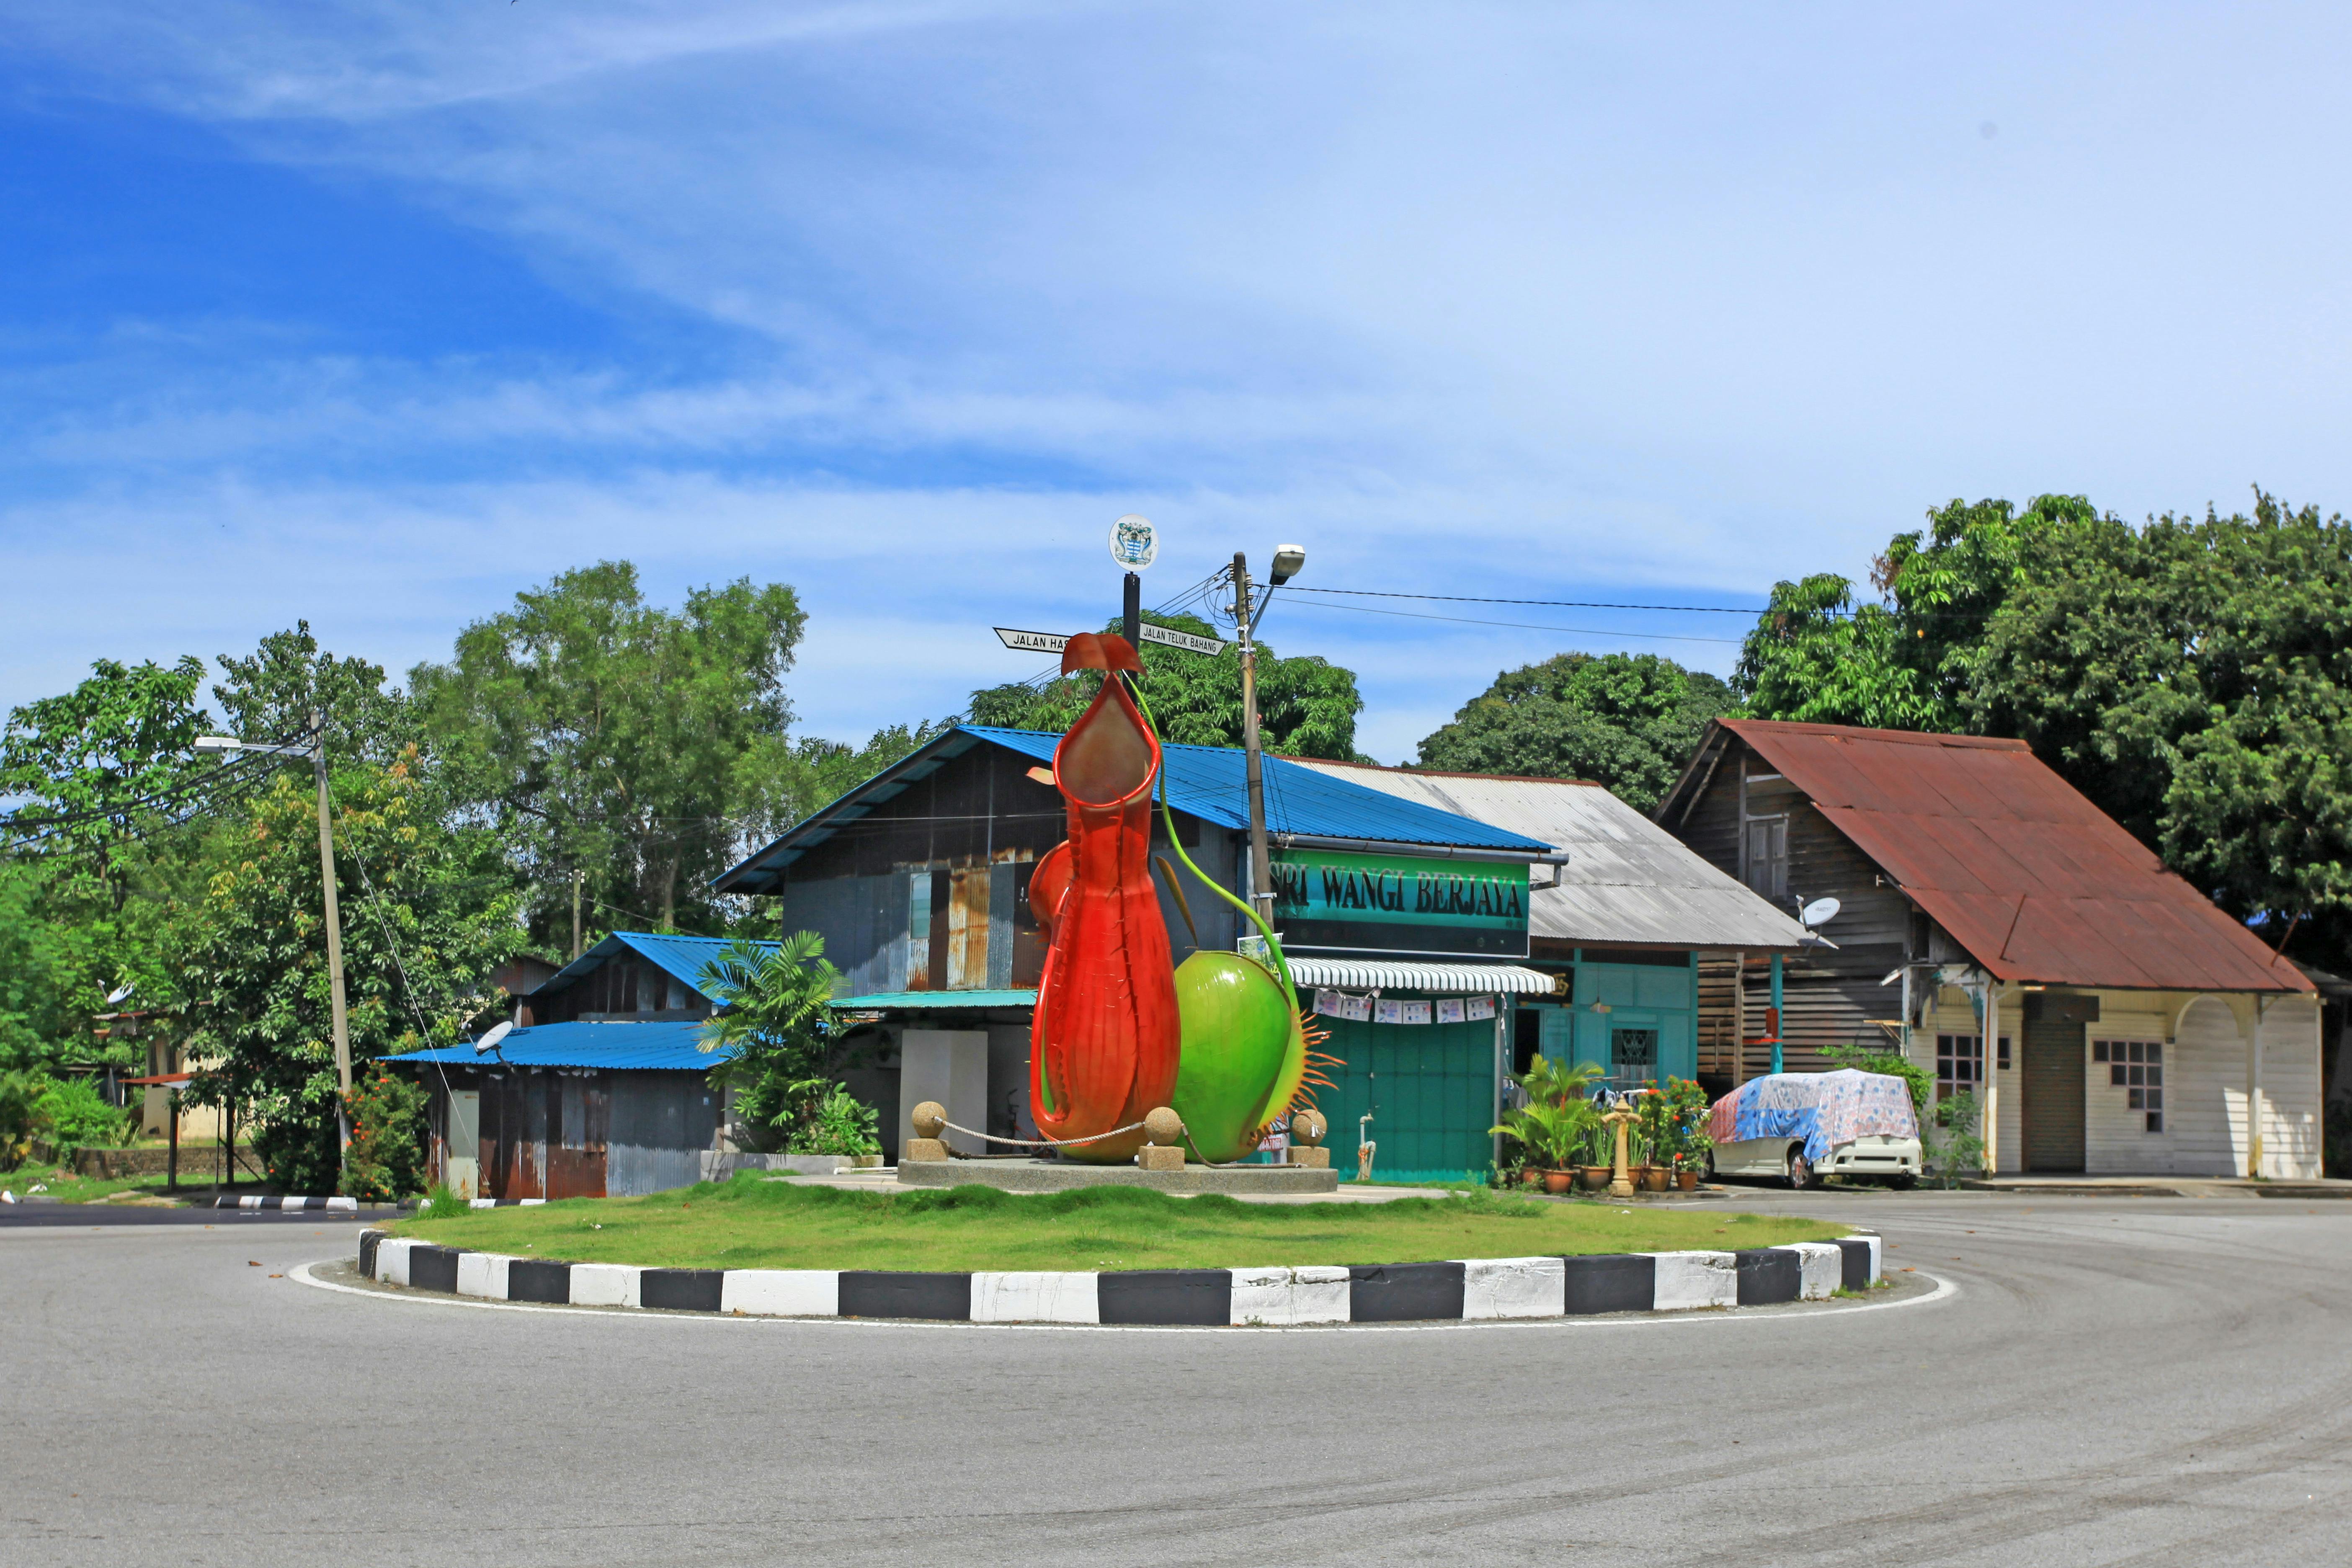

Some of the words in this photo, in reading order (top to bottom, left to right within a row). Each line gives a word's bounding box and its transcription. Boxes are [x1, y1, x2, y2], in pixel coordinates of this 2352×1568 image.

[1014, 634, 1046, 647] JALAN
[1144, 627, 1165, 640] JALAN
[1168, 632, 1187, 645] TELUK
[1191, 638, 1216, 652] BAHANG
[1269, 861, 1310, 906] SRI
[1320, 865, 1405, 912] WANGI
[1415, 871, 1523, 918] BERJAYA
